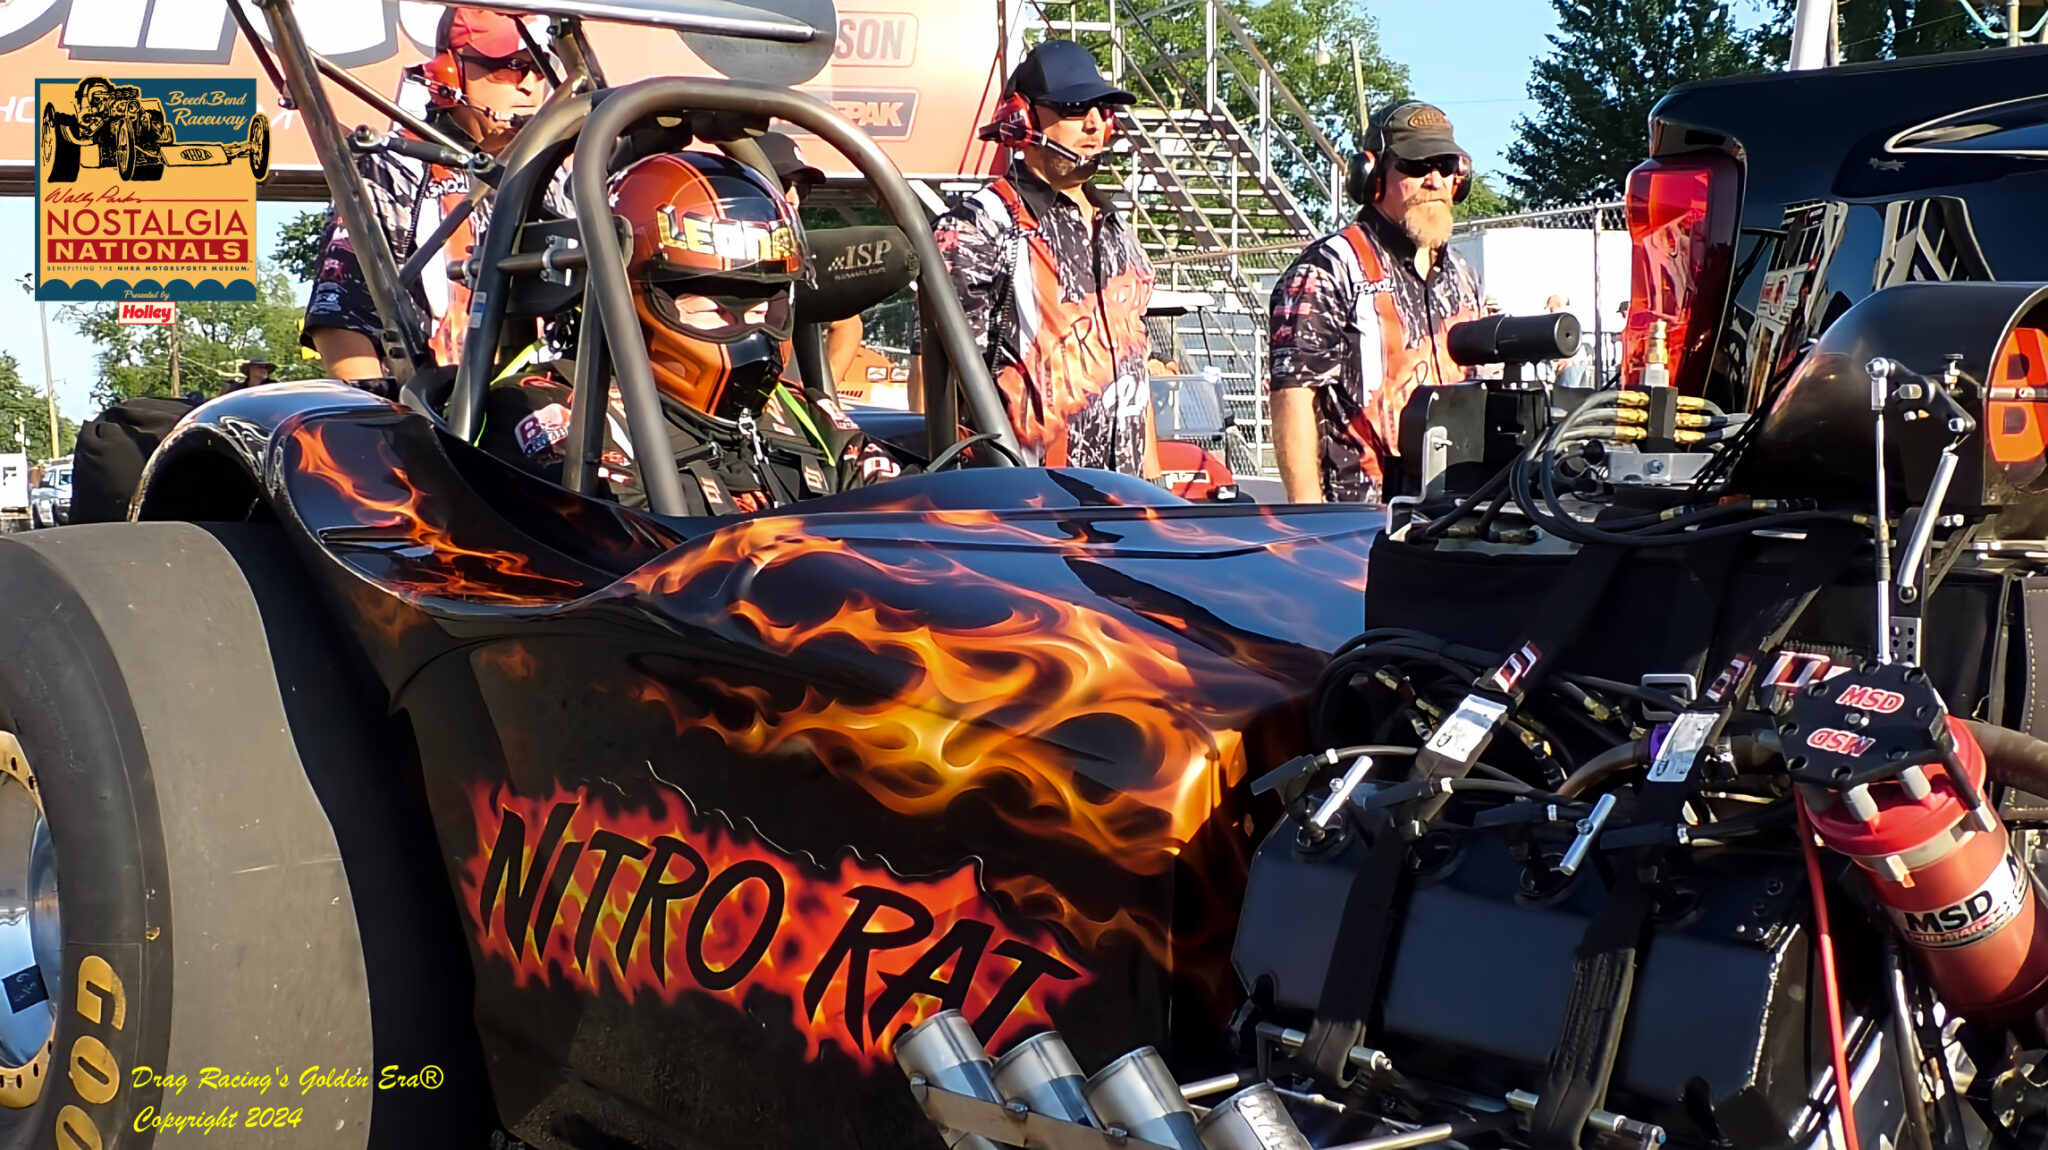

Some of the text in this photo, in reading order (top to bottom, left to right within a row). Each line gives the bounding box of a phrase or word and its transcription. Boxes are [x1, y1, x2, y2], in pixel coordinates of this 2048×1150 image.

[845, 239, 892, 270] ISP
[1836, 685, 1905, 714] MSD
[1807, 728, 1875, 757] MSD
[479, 801, 786, 990] NITRO
[1904, 890, 1993, 932] MSD
[803, 885, 1082, 1052] RAT
